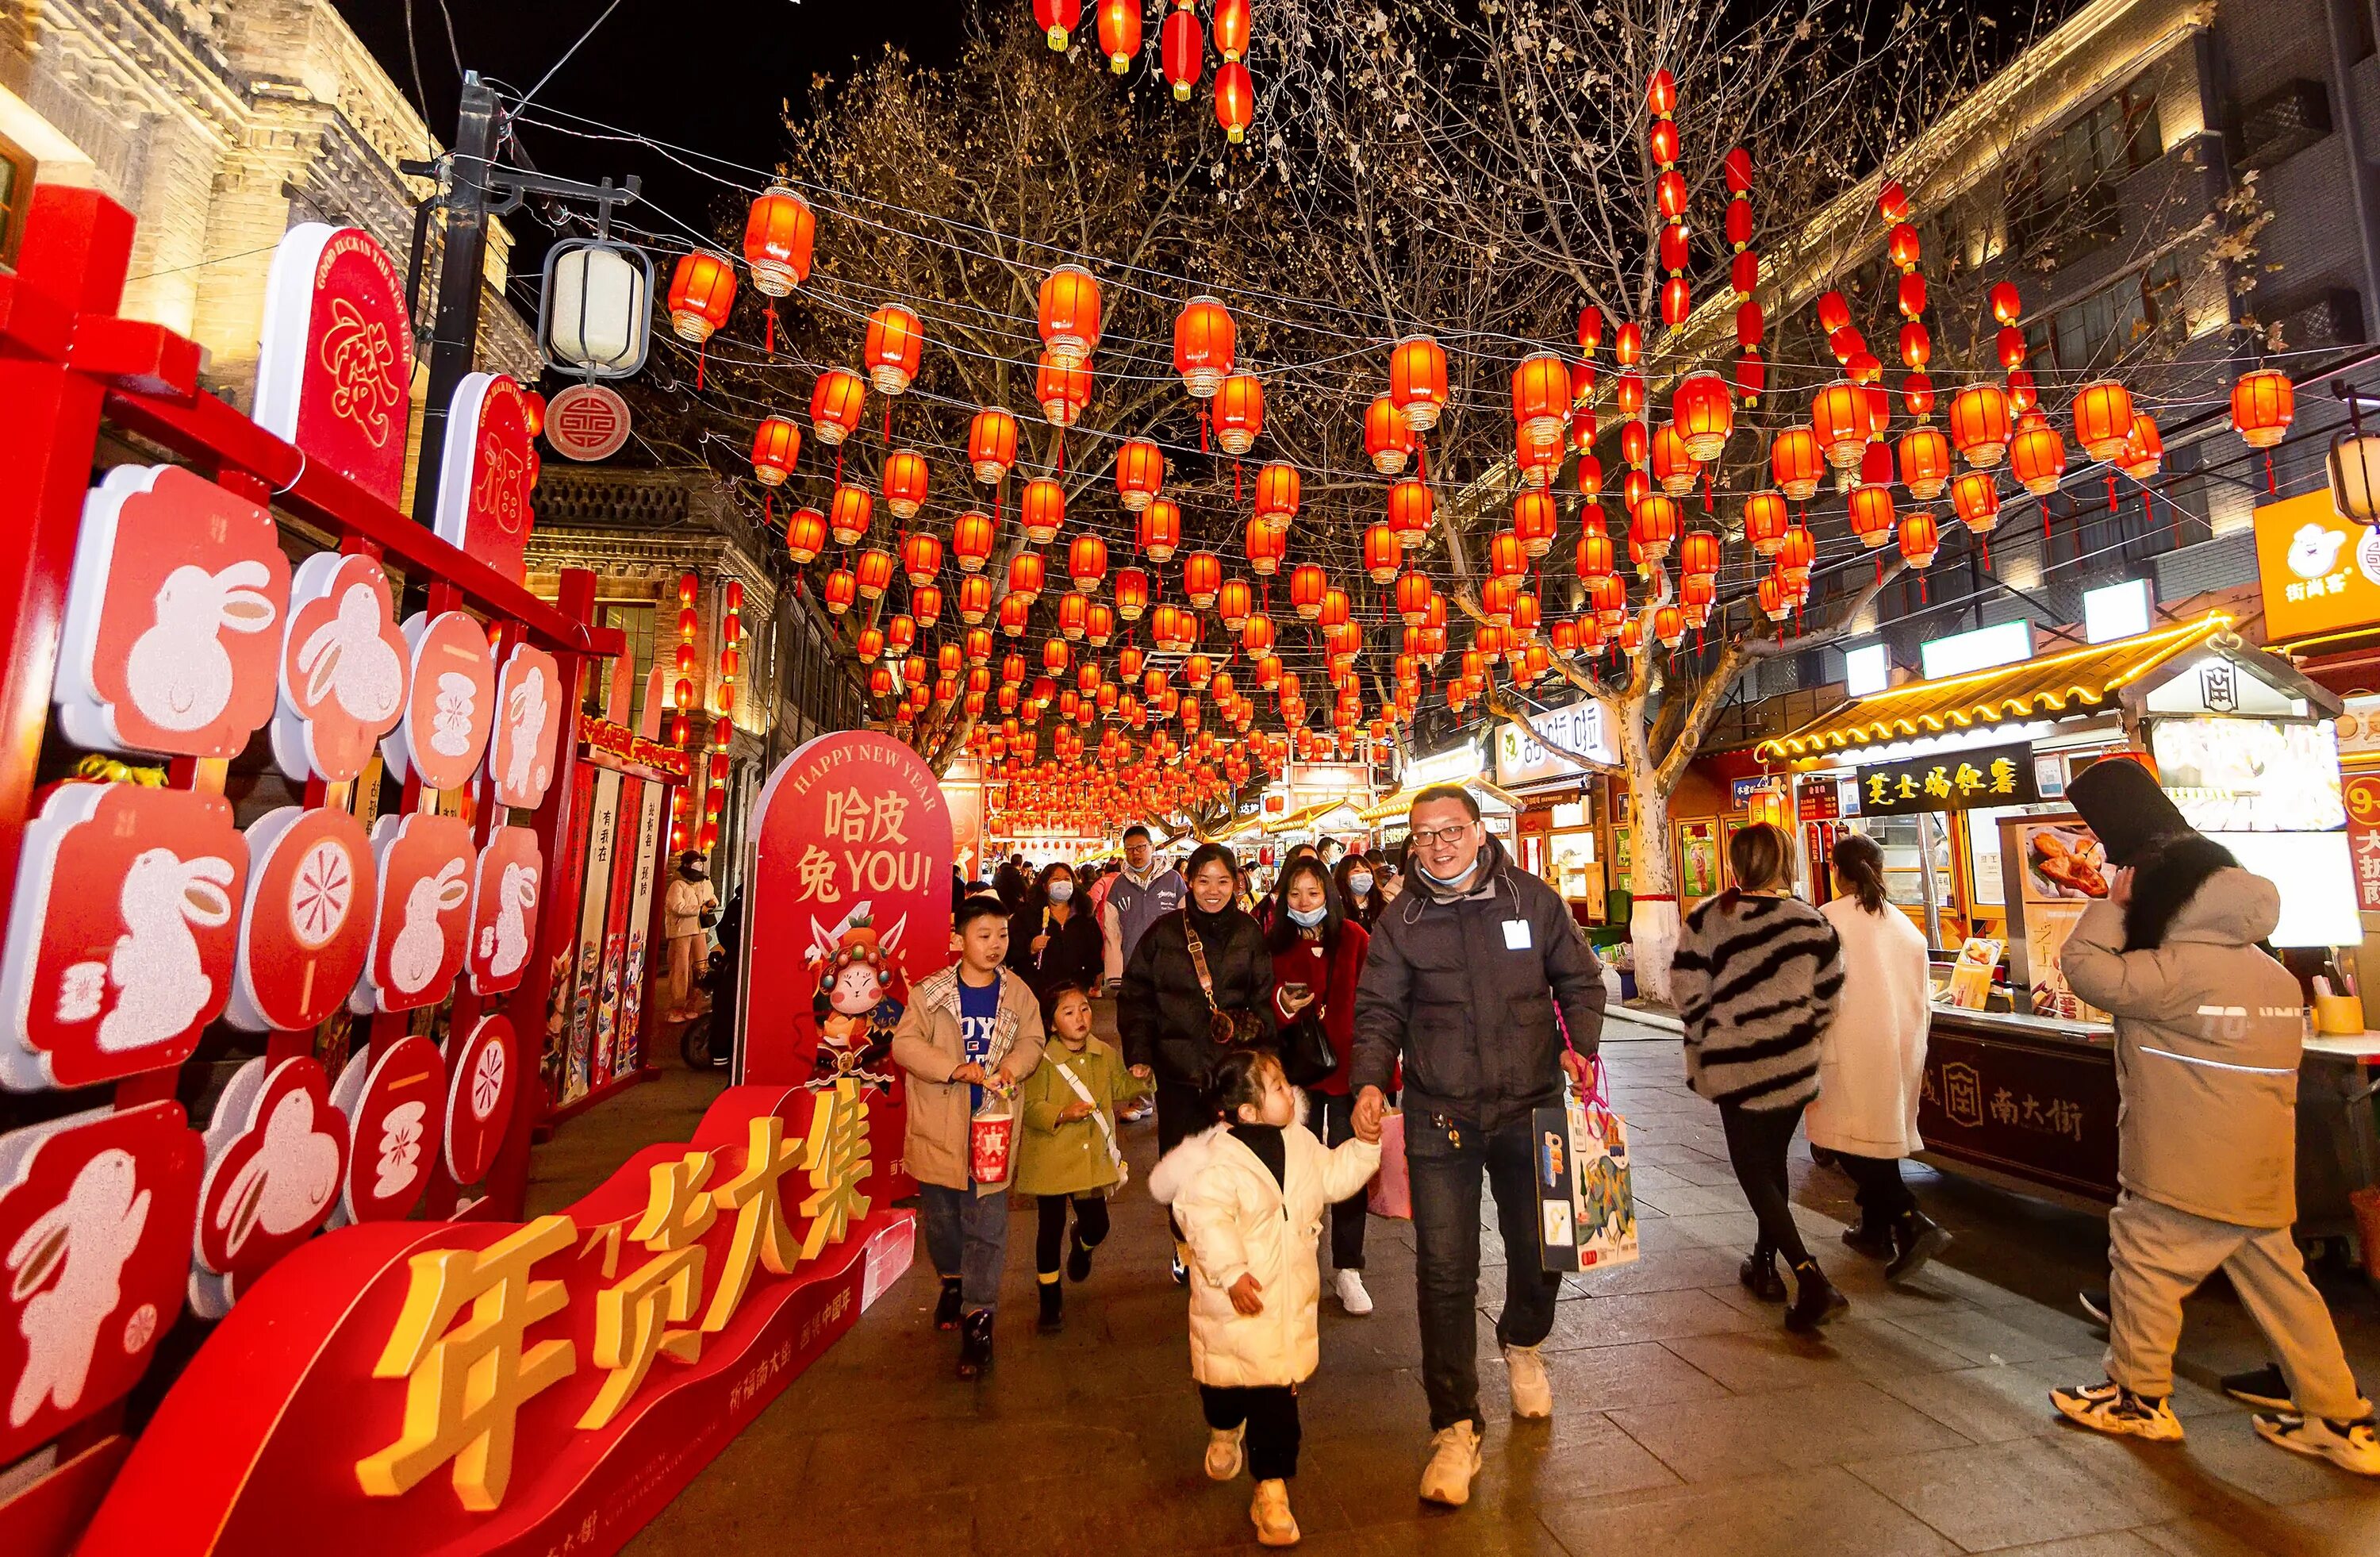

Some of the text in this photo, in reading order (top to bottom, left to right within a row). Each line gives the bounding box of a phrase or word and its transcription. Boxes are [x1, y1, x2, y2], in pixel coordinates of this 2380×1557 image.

[317, 247, 337, 290] GOOD
[336, 236, 359, 252] LUCK
[372, 252, 390, 279] THE
[386, 278, 405, 315] NEW
[399, 323, 410, 363] YEAR
[480, 394, 493, 428] GOOD
[2286, 573, 2347, 603] 街尚客
[793, 744, 937, 813] HAPPY NEW YEAR
[597, 809, 612, 863] 有我在
[824, 786, 910, 845] 哈皮
[1990, 1086, 2083, 1142] 南大街
[355, 1078, 873, 1512] 年货大集
[729, 1338, 792, 1415] 祈福南大街
